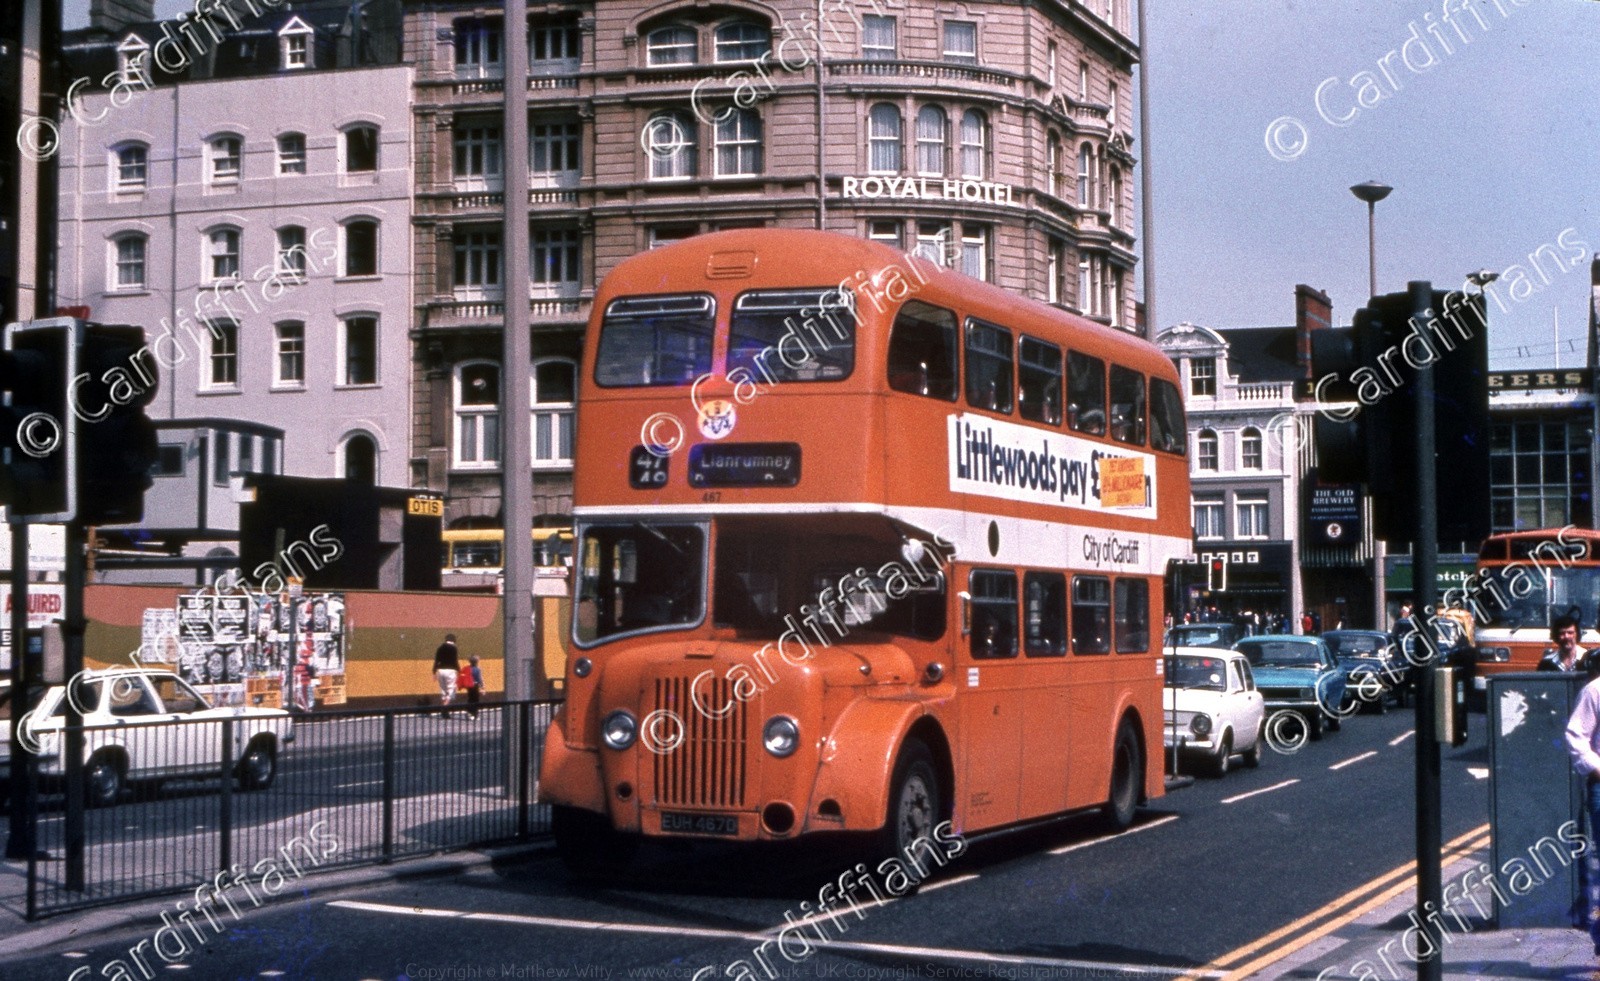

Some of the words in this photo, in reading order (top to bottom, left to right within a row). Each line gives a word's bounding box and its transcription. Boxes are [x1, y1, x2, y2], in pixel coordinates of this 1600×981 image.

[843, 176, 936, 199] ROYAL
[943, 179, 1020, 207] HOTEL
[955, 420, 1057, 493] Littlewoods
[1060, 456, 1087, 504] pay
[412, 500, 439, 513] OTIS
[702, 492, 722, 503] 467
[1083, 534, 1102, 568] City
[1102, 539, 1112, 562] of
[1111, 537, 1139, 565] Cardiff
[5, 594, 62, 613] AUIRED
[663, 813, 693, 829] EUH
